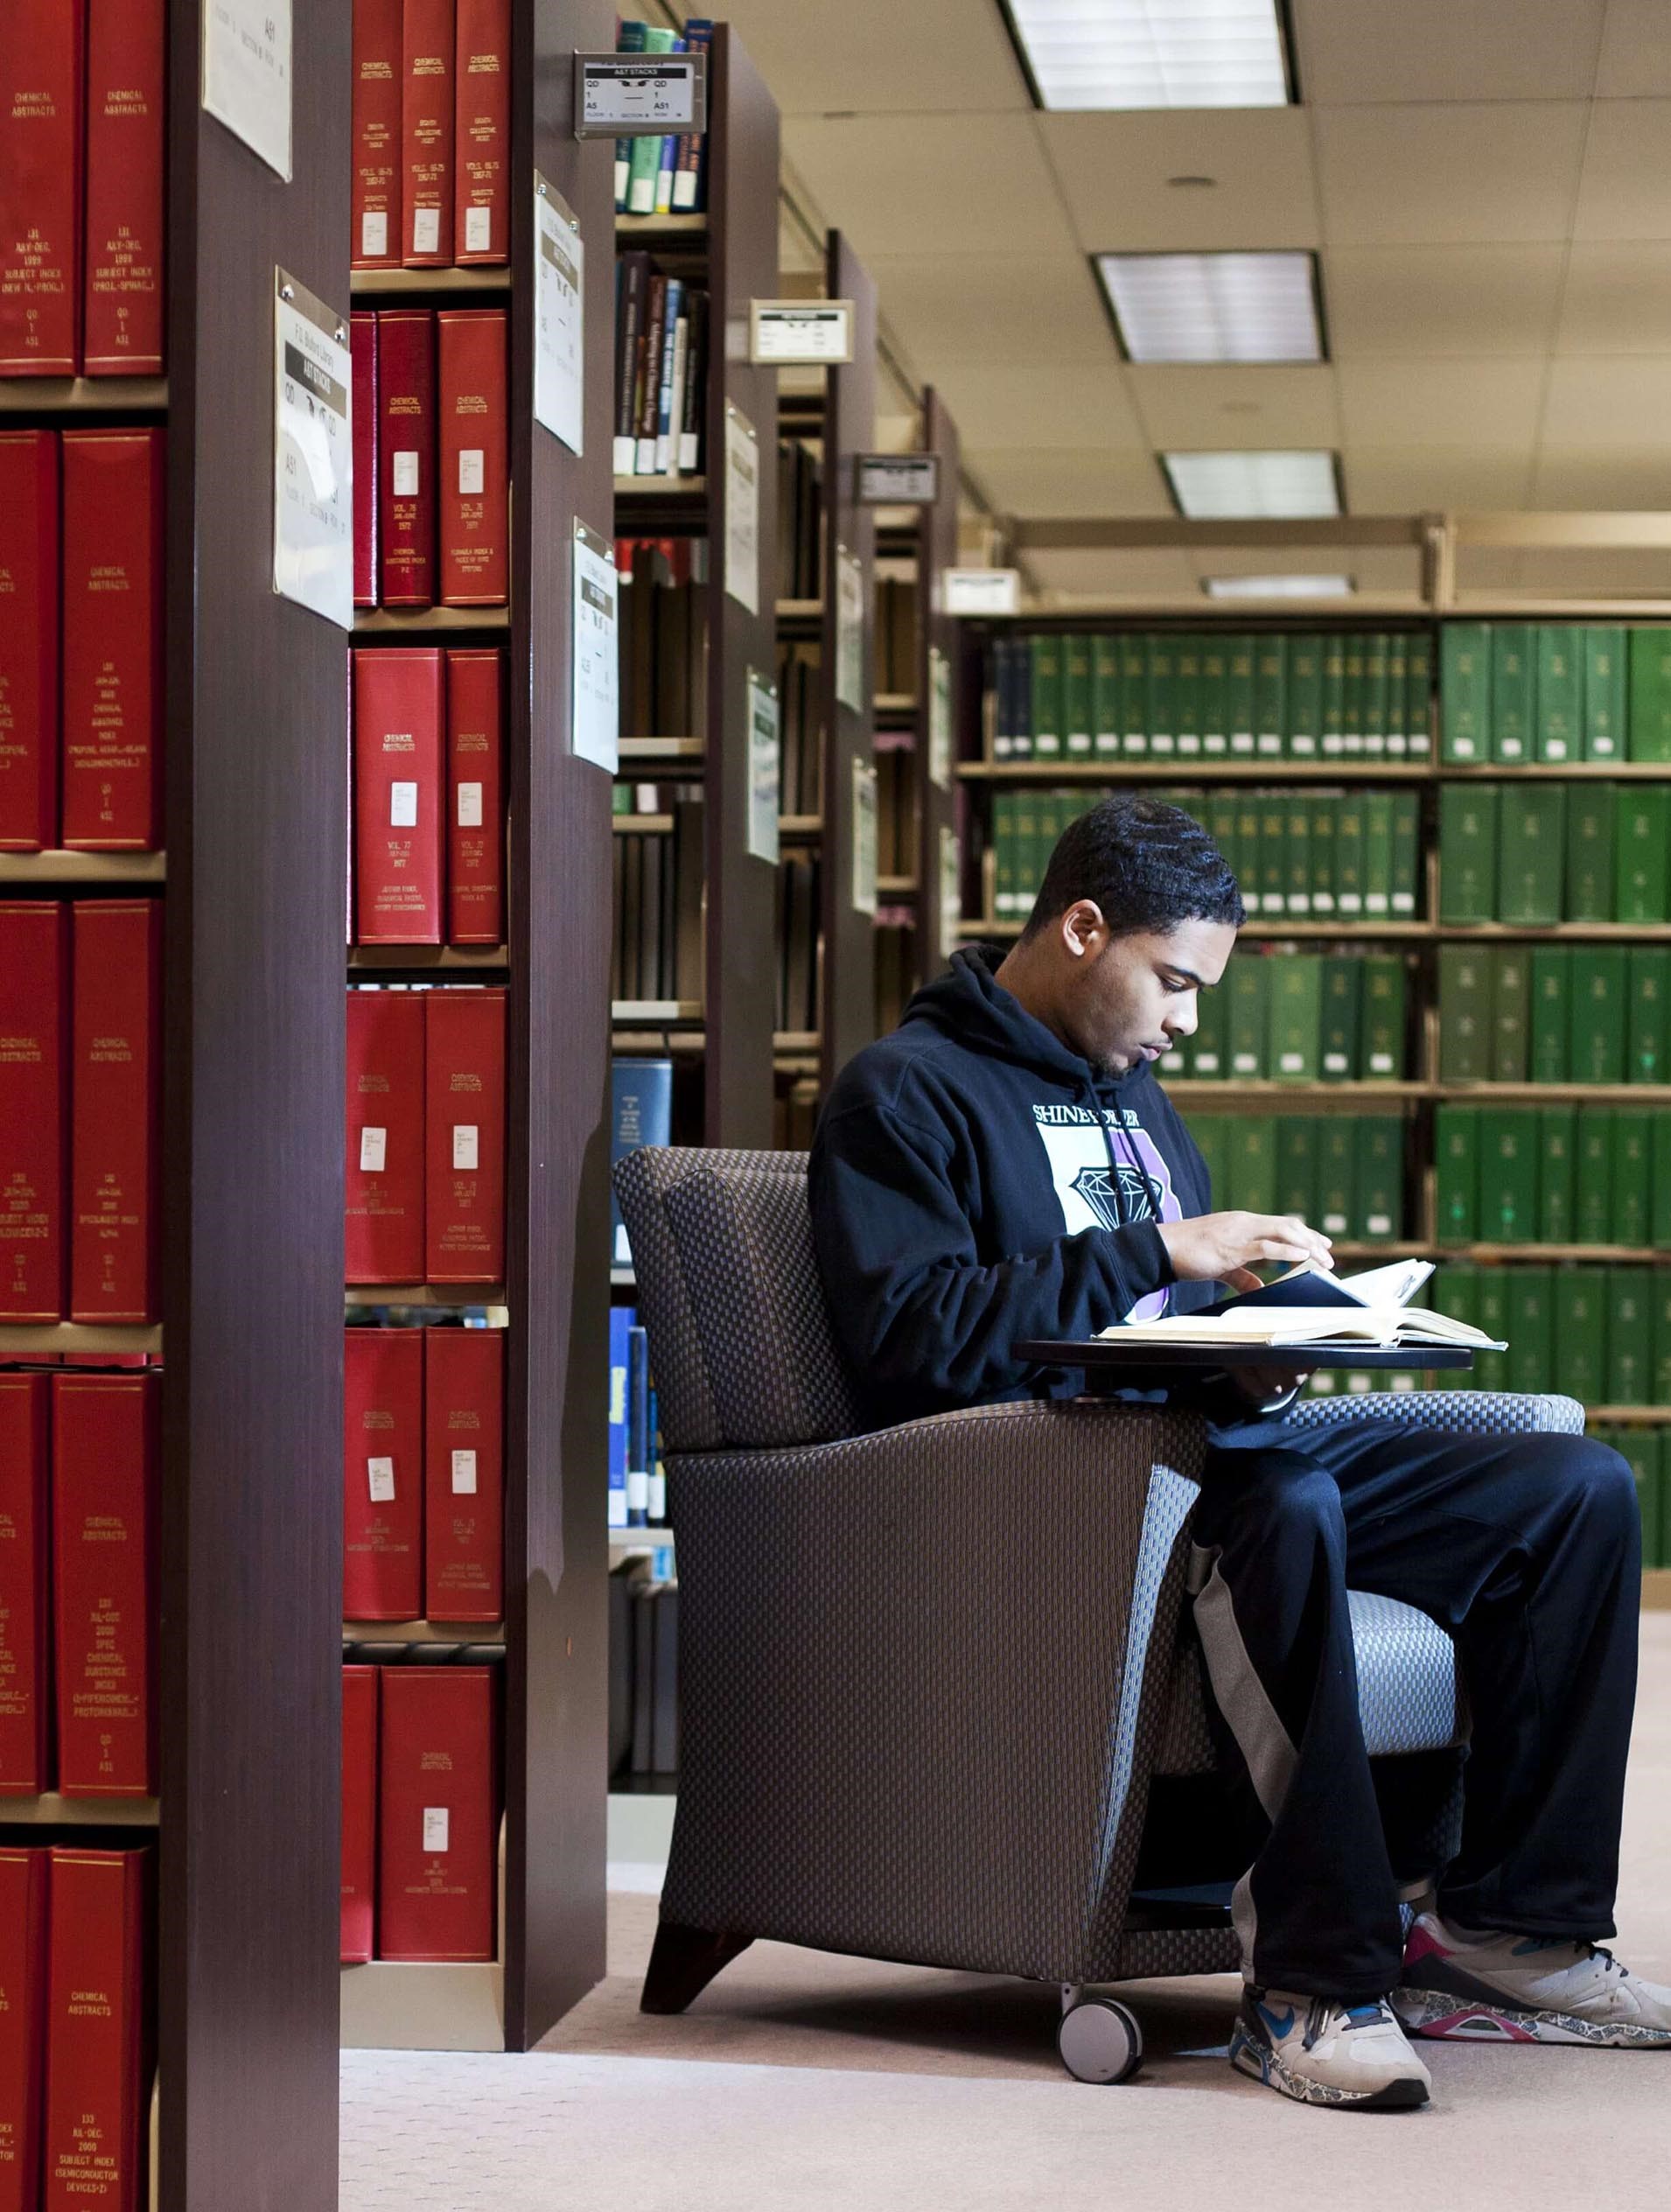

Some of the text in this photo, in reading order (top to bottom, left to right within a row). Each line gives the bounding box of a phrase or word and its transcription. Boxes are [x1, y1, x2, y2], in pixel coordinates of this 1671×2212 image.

[413, 66, 444, 75] ABSTRACTS
[468, 64, 500, 73] ABSTRACTS
[15, 92, 52, 103] CHEMICAL
[107, 90, 143, 102] CHEMICAL
[11, 105, 56, 117] ABSTRACTS
[103, 103, 148, 115] ABSTRACTS
[4, 269, 61, 280] SUBJECT INDEX
[96, 267, 152, 277] SUBJECT INDEX
[91, 567, 126, 578] CHEMICAL
[88, 581, 129, 591] ABSTRACTS
[93, 1038, 129, 1048] CHEMICAL
[90, 1052, 131, 1061] ABSTRACTS
[85, 1516, 122, 1527] CHEMICAL
[82, 1530, 127, 1541] ABSTRACTS
[87, 1653, 123, 1662] CHEMICAL
[71, 1991, 108, 2003] CHEMICAL
[67, 2005, 111, 2016] ABSTRACTS
[79, 2141, 96, 2152] 2000
[59, 2154, 115, 2167] SUBJECT INDEX
[55, 2167, 119, 2180] (SEMICONDUCTOR
